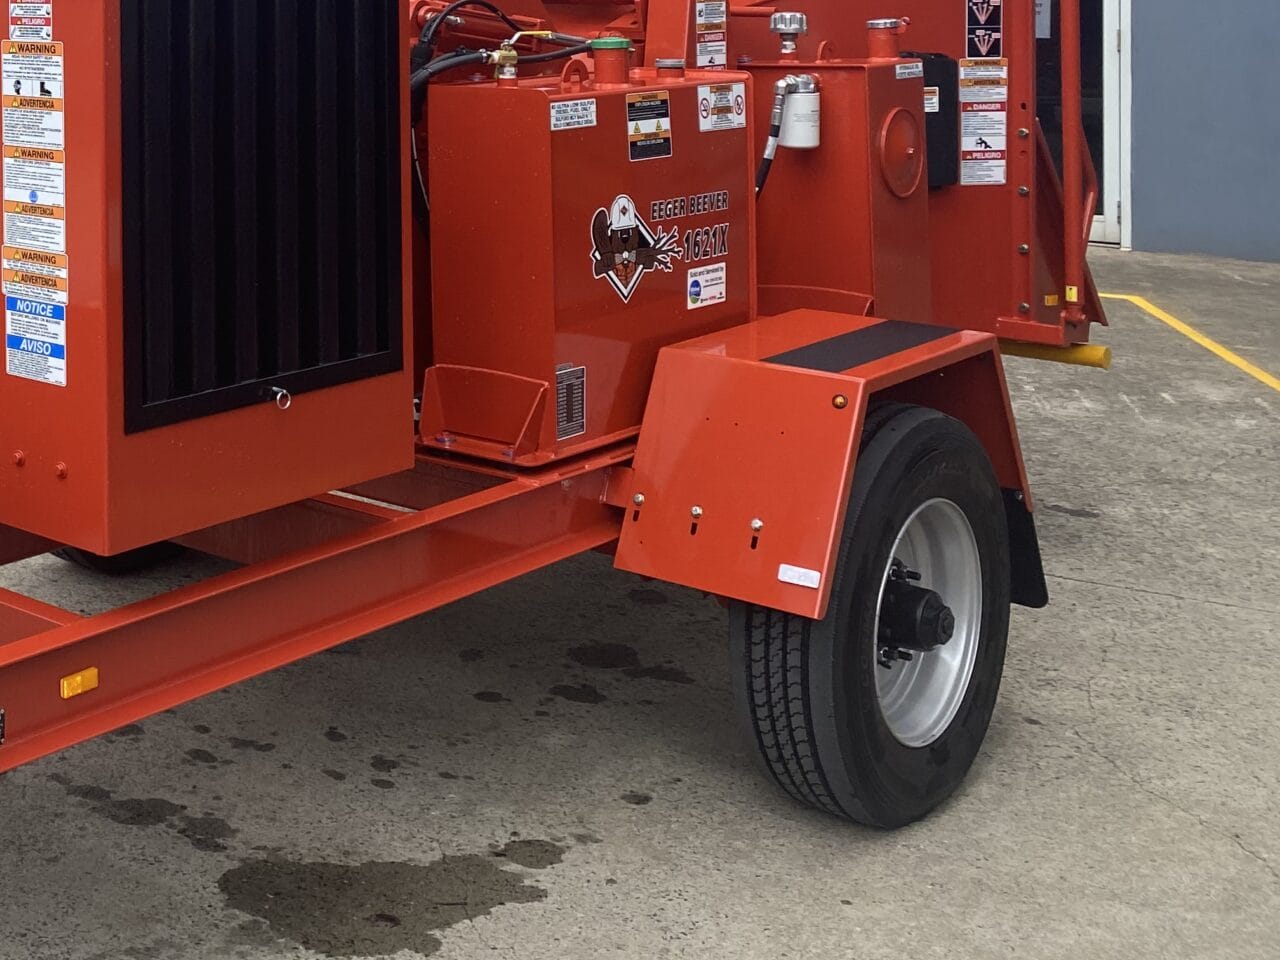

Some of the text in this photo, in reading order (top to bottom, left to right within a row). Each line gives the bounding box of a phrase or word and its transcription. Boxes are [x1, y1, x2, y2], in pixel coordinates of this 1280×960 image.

[17, 43, 56, 54] WARNING
[19, 97, 55, 109] ADVERTENCIA
[972, 103, 1001, 111] DANGER
[21, 149, 55, 160] WARNING
[972, 151, 1002, 159] PELIGRO
[21, 204, 55, 216] ADVERTENCIA
[650, 190, 729, 222] EEGER BEEVER
[683, 223, 730, 263] 1621X
[21, 251, 57, 265] WARNING
[20, 274, 58, 288] ADVERTENCIA
[16, 299, 54, 317] NOTICE
[19, 338, 52, 355] AVISO
